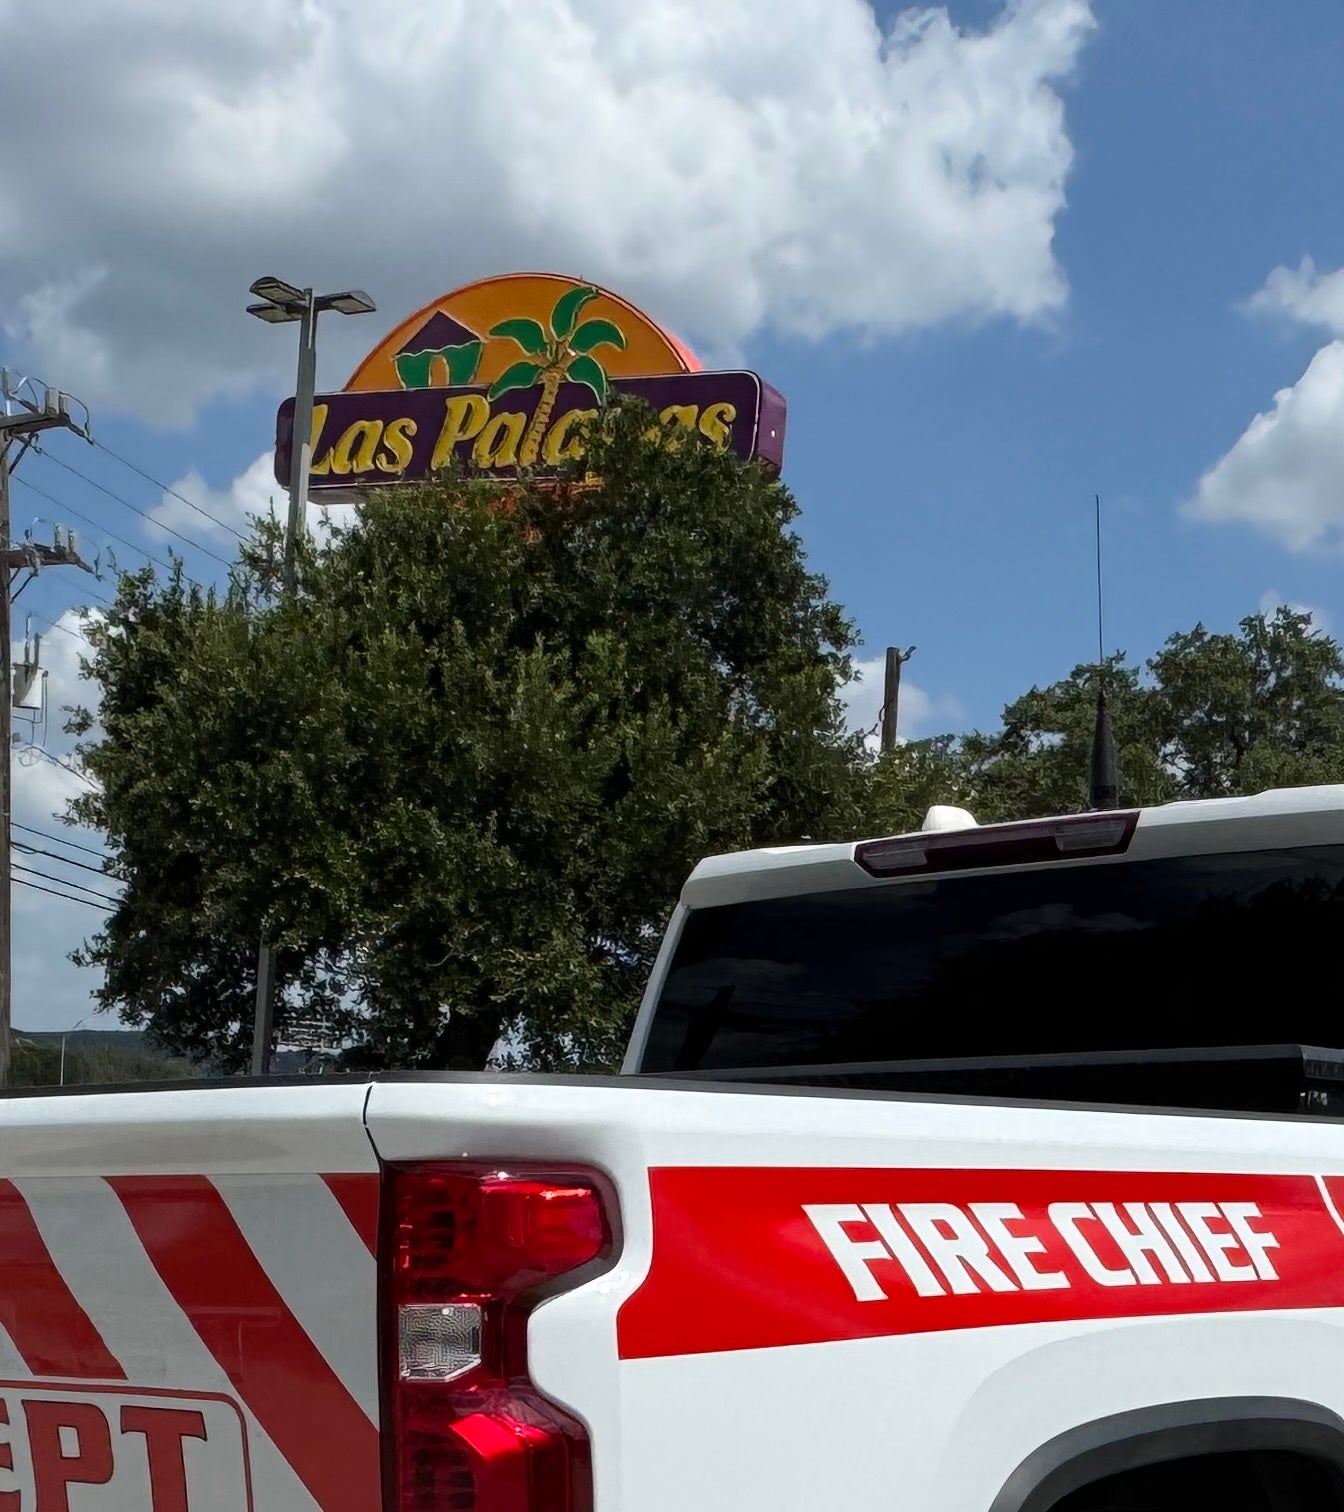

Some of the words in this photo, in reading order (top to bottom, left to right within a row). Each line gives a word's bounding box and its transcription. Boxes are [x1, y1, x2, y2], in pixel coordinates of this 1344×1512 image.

[309, 403, 418, 475] Las
[801, 1202, 1072, 1303] FIRE
[1047, 1201, 1280, 1288] CHIEF
